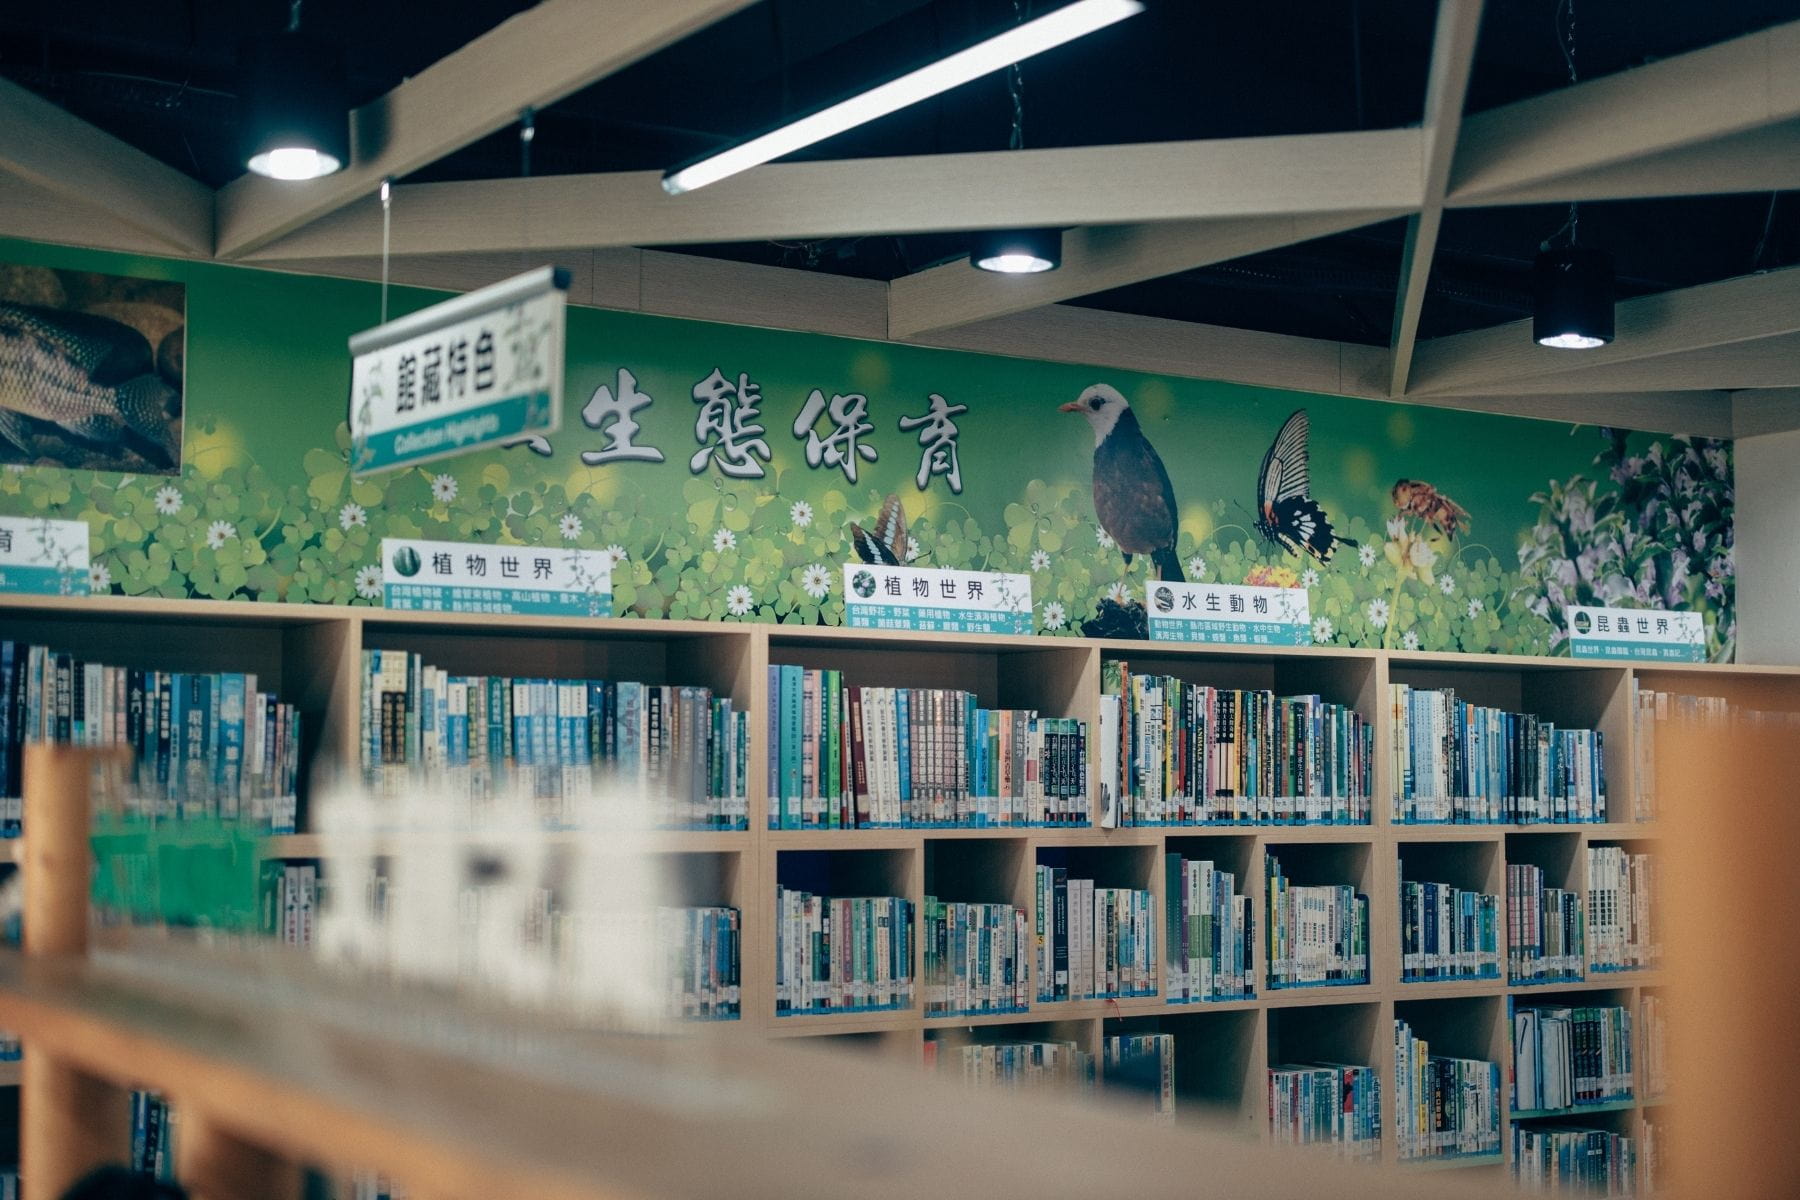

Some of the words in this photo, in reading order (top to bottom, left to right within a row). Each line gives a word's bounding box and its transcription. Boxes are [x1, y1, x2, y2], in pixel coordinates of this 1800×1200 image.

[396, 329, 494, 413] 館藏特色
[502, 366, 969, 494] 生態保育
[431, 552, 553, 579] 植物世界
[884, 575, 985, 599] 植物世界
[1181, 591, 1269, 614] 水生動物
[1597, 615, 1669, 635] 昆蟲世界
